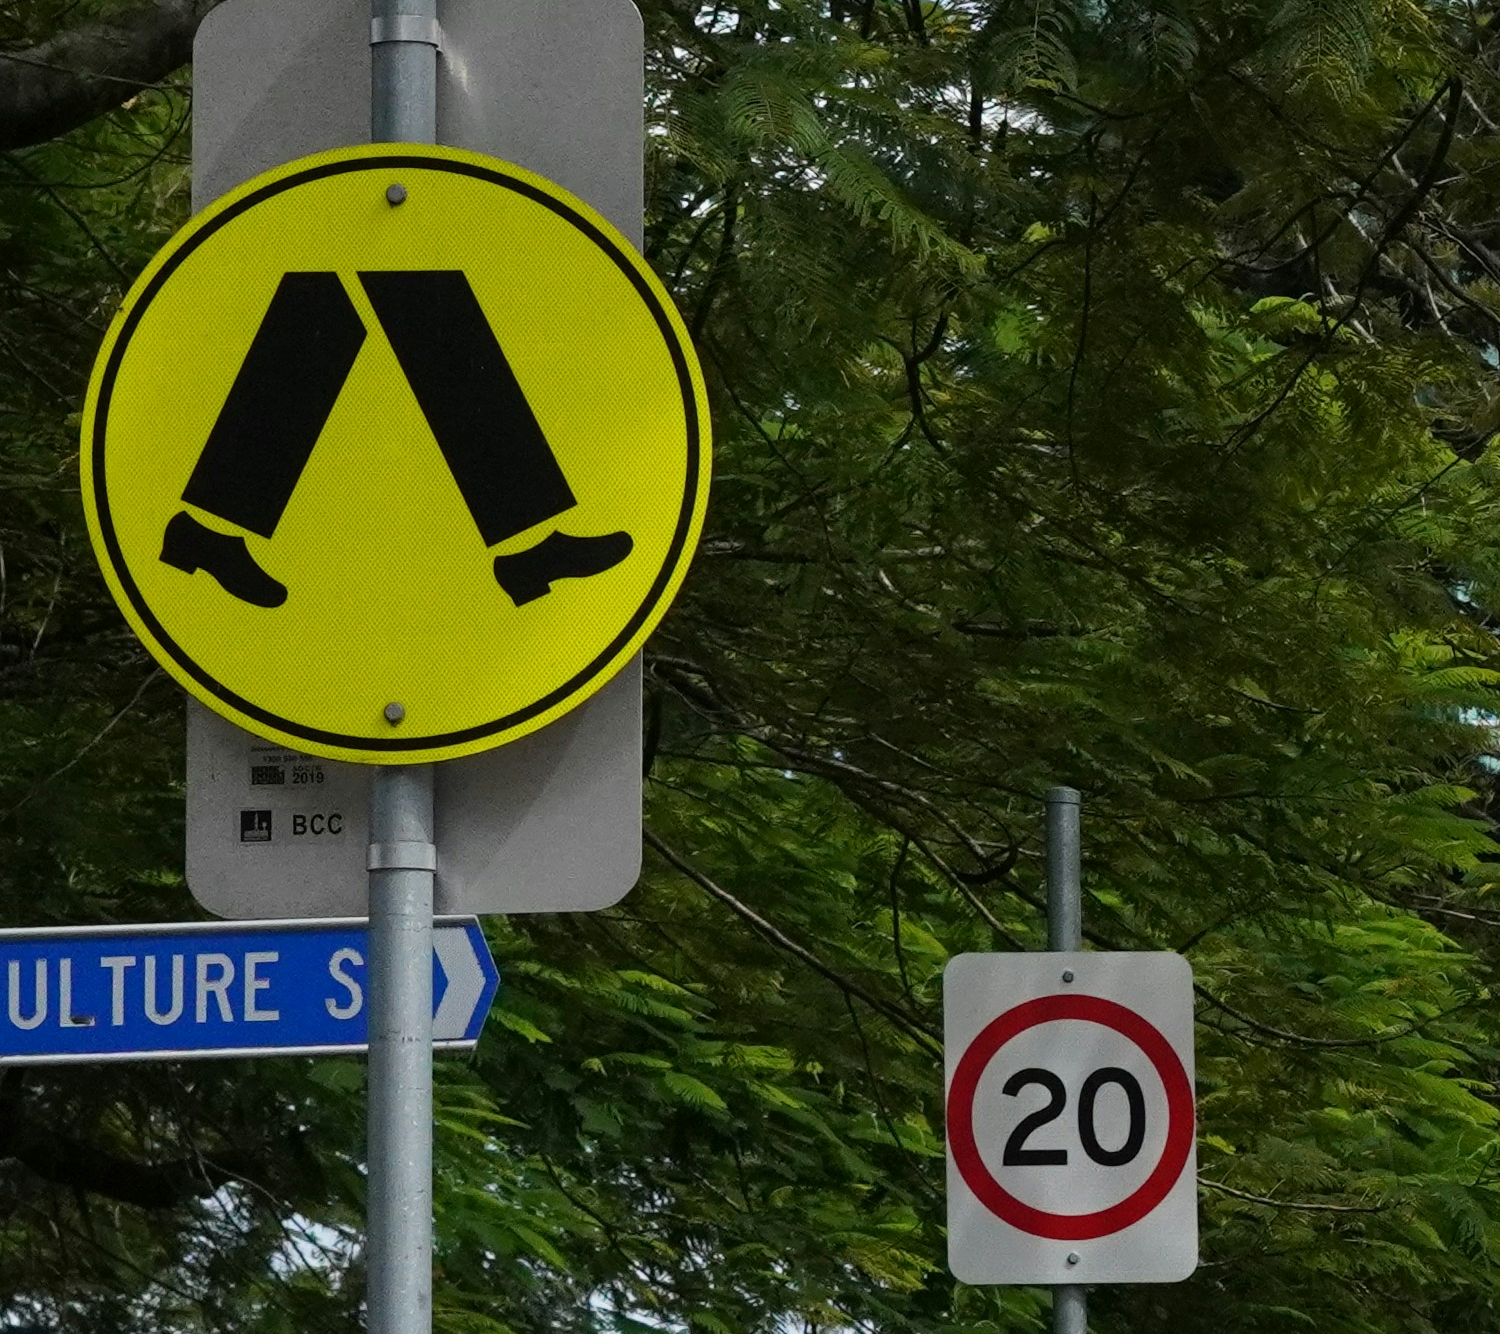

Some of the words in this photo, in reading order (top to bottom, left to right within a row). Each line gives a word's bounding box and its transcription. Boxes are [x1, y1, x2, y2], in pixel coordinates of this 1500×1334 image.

[292, 771, 324, 785] 2019
[292, 813, 342, 835] BCC
[7, 951, 280, 1030] ULTURE
[1002, 1067, 1146, 1167] 20
